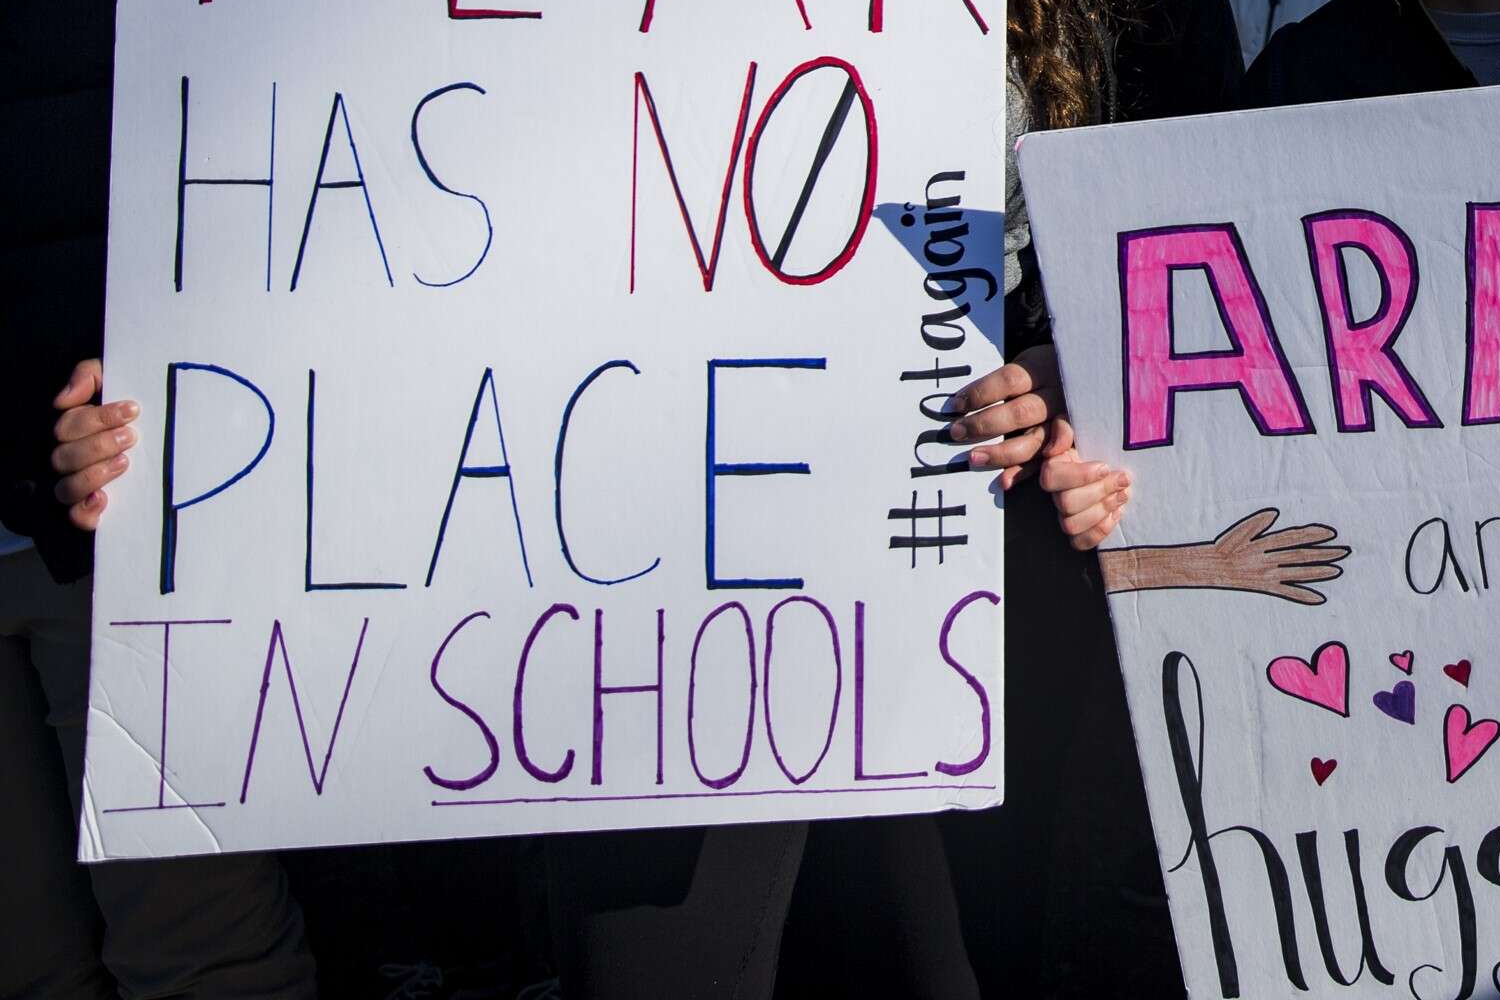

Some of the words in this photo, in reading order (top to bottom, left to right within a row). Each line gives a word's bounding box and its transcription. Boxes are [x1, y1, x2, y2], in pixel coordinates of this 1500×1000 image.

[174, 75, 493, 293] HAS
[628, 55, 878, 295] NO
[160, 358, 827, 594] PLACE
[888, 170, 999, 571] #notagain
[103, 617, 369, 813] IN
[422, 590, 1002, 792] SCHOOLS
